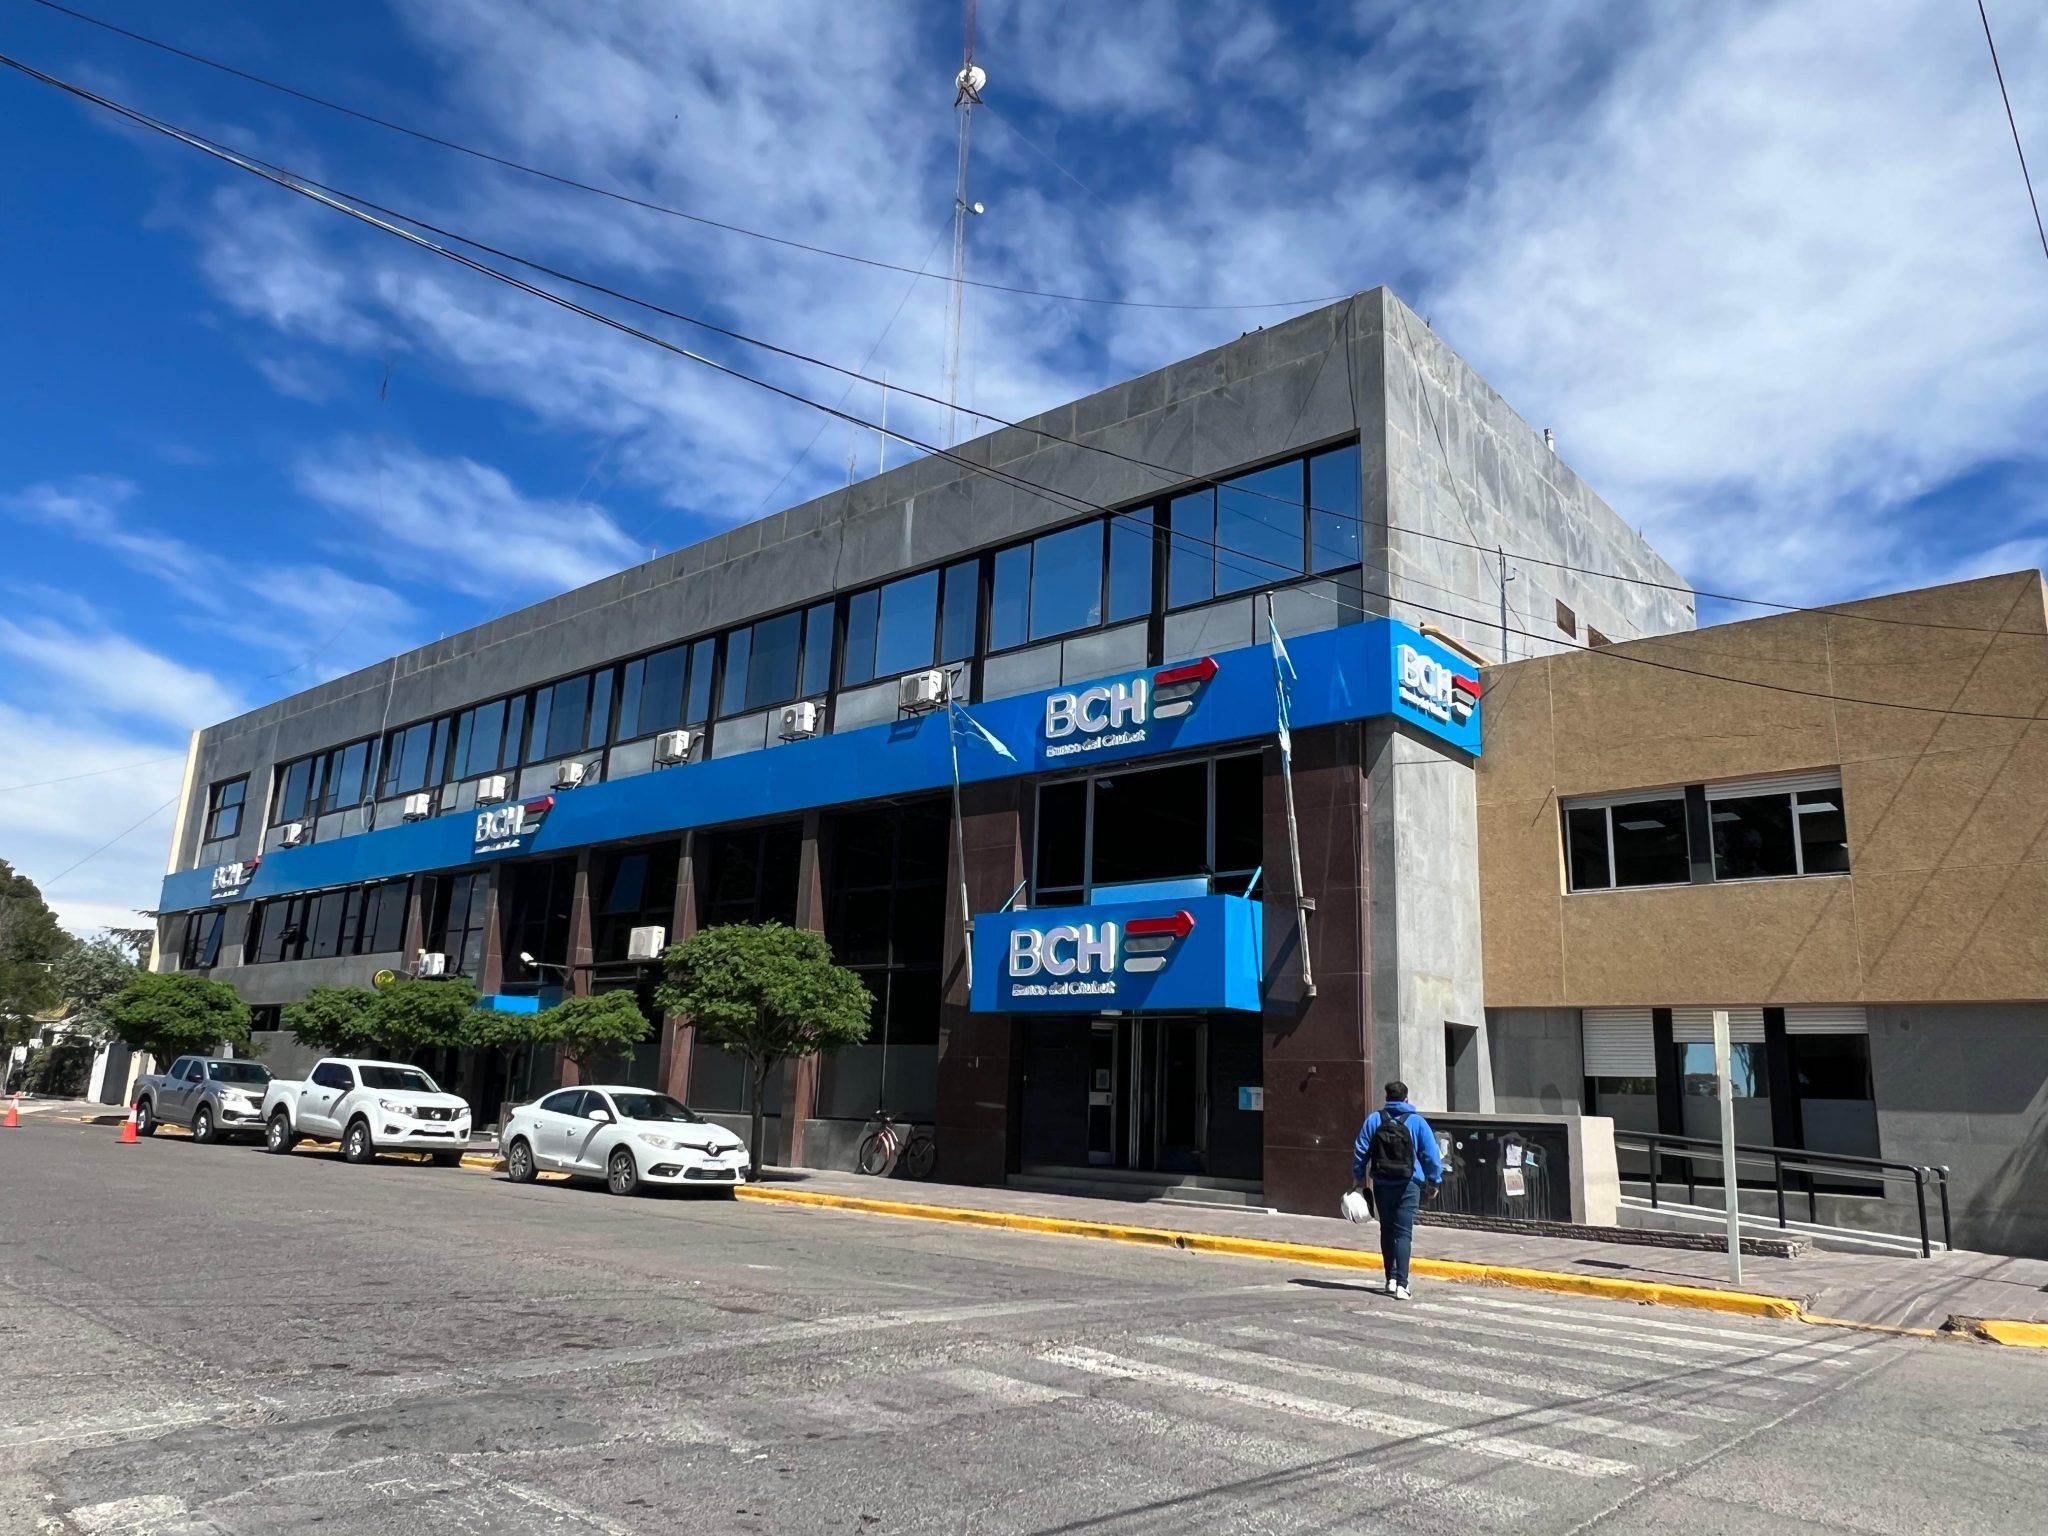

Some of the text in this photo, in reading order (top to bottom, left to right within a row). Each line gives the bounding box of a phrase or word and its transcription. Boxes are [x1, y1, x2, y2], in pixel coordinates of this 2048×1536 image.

[1397, 644, 1452, 706] BCH
[1046, 678, 1146, 738] BCH
[475, 804, 524, 842] BCH
[212, 862, 243, 890] BCH
[1009, 922, 1117, 976] BCH
